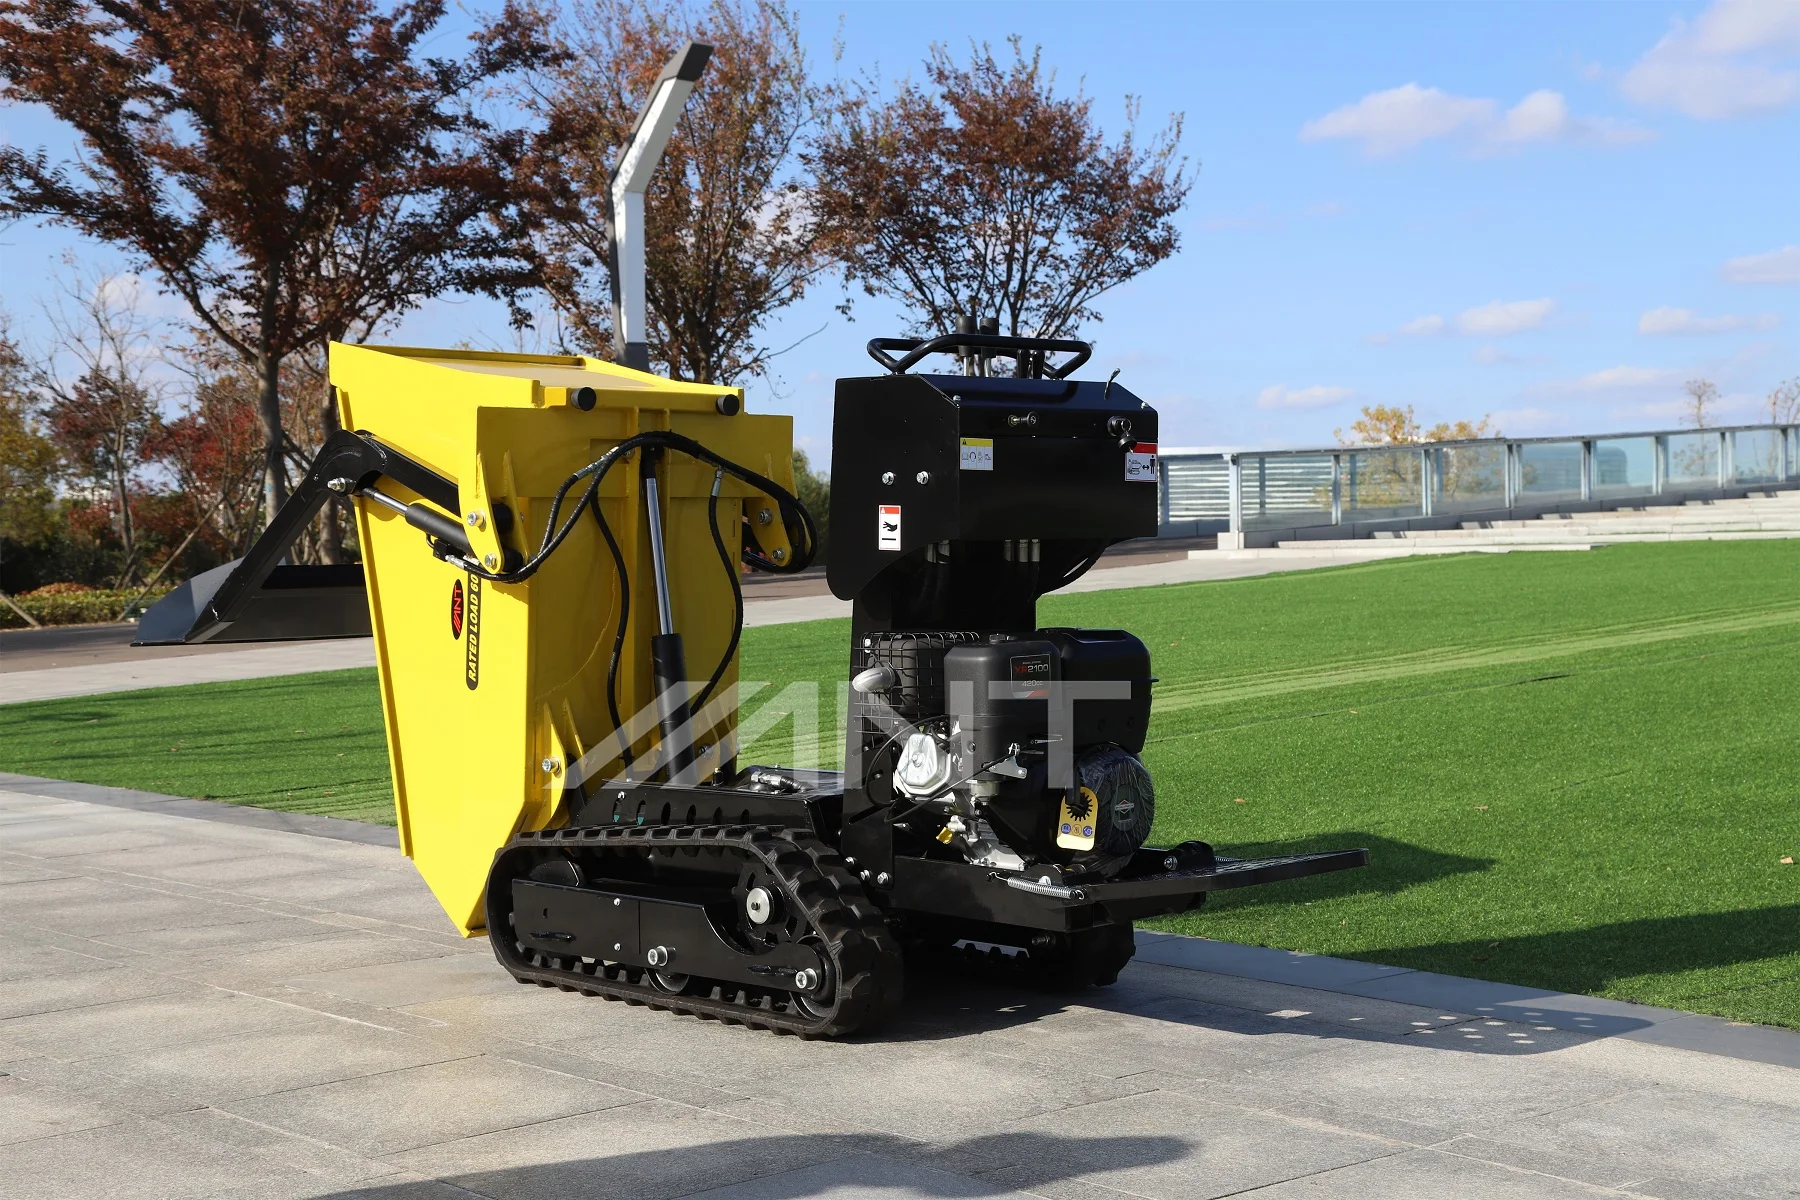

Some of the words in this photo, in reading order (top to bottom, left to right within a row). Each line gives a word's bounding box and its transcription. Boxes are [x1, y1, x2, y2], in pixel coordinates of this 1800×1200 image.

[469, 593, 479, 633] LOAD
[468, 633, 477, 682] RATED
[1015, 663, 1049, 673] XR2100
